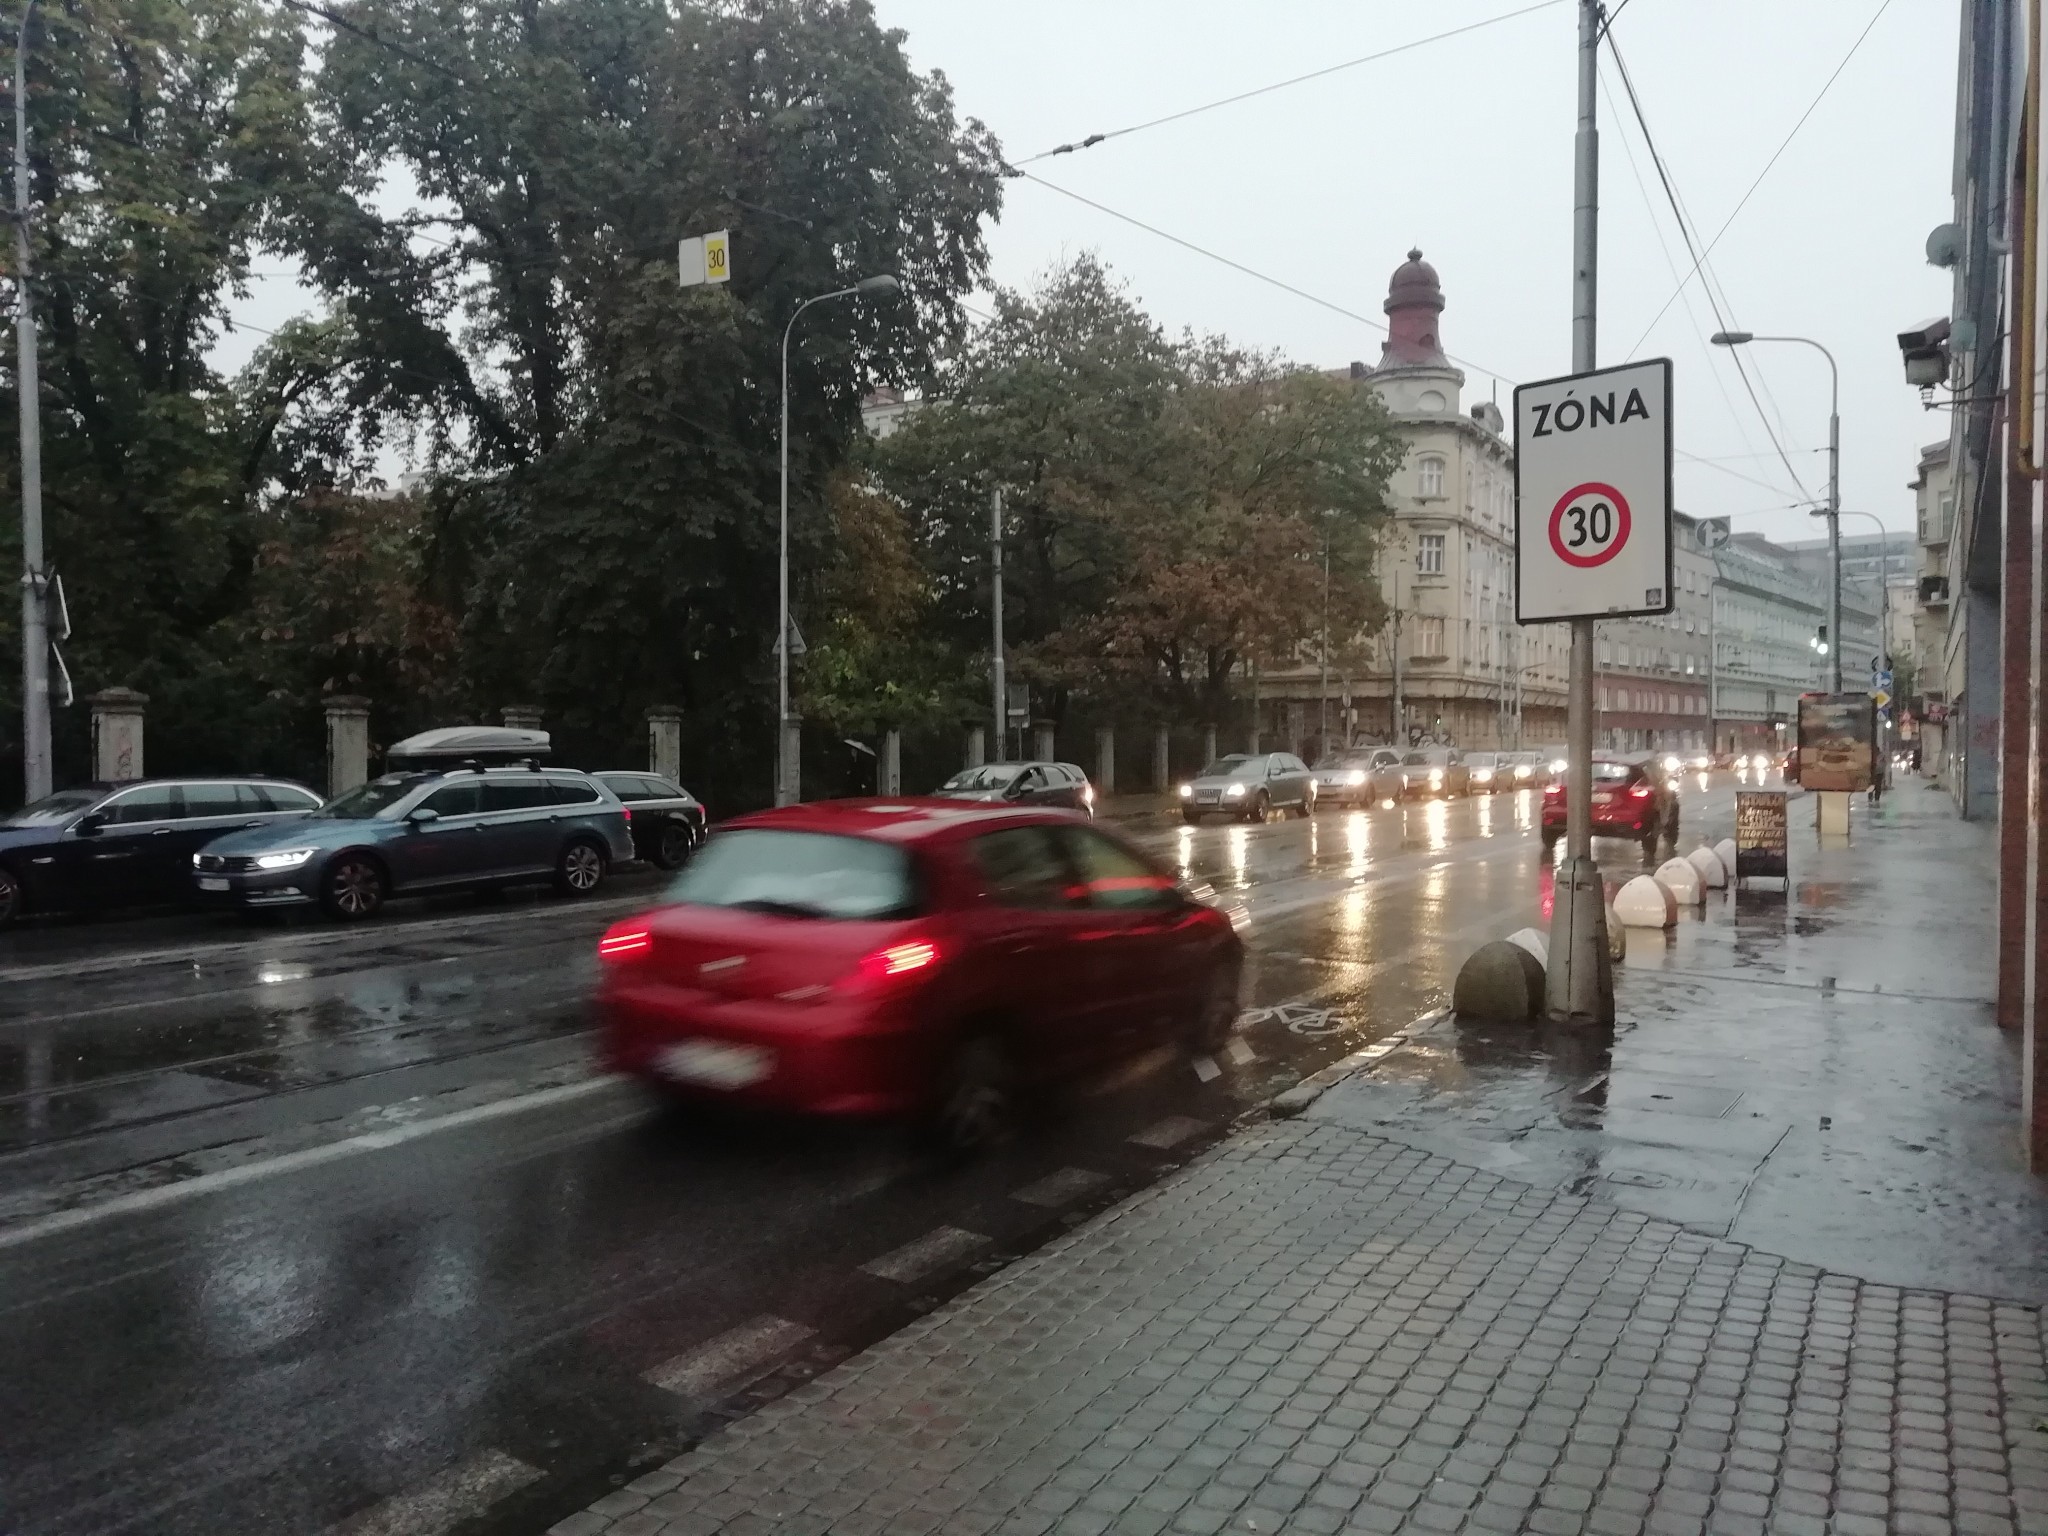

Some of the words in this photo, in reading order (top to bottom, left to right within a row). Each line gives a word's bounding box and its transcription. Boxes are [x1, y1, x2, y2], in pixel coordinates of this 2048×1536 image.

[708, 248, 725, 269] 30
[1532, 388, 1649, 437] ZÓNA
[1567, 503, 1611, 547] 30
